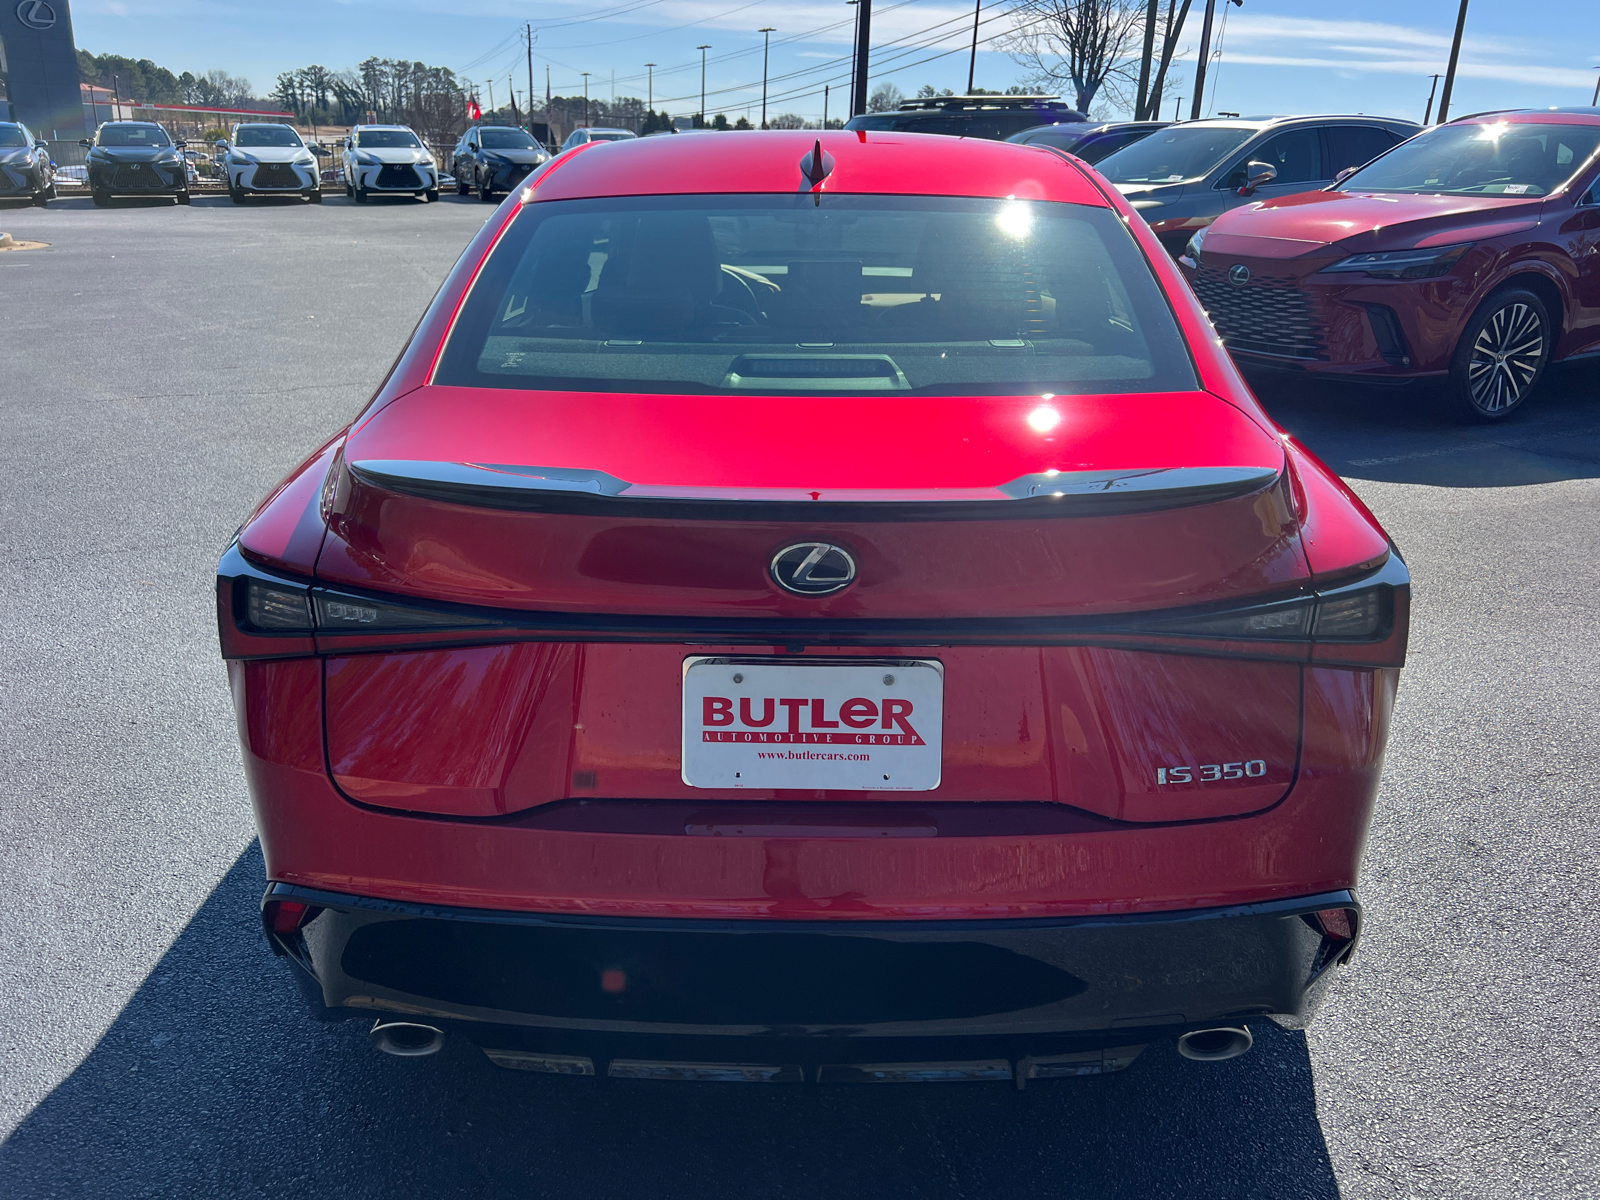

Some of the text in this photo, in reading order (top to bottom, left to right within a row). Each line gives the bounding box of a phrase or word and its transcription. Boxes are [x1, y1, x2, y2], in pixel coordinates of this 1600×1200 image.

[704, 732, 918, 745] AUTOMOTIVE GROUP
[757, 750, 870, 762] www.butlercars.com
[1157, 759, 1267, 785] IS 350
